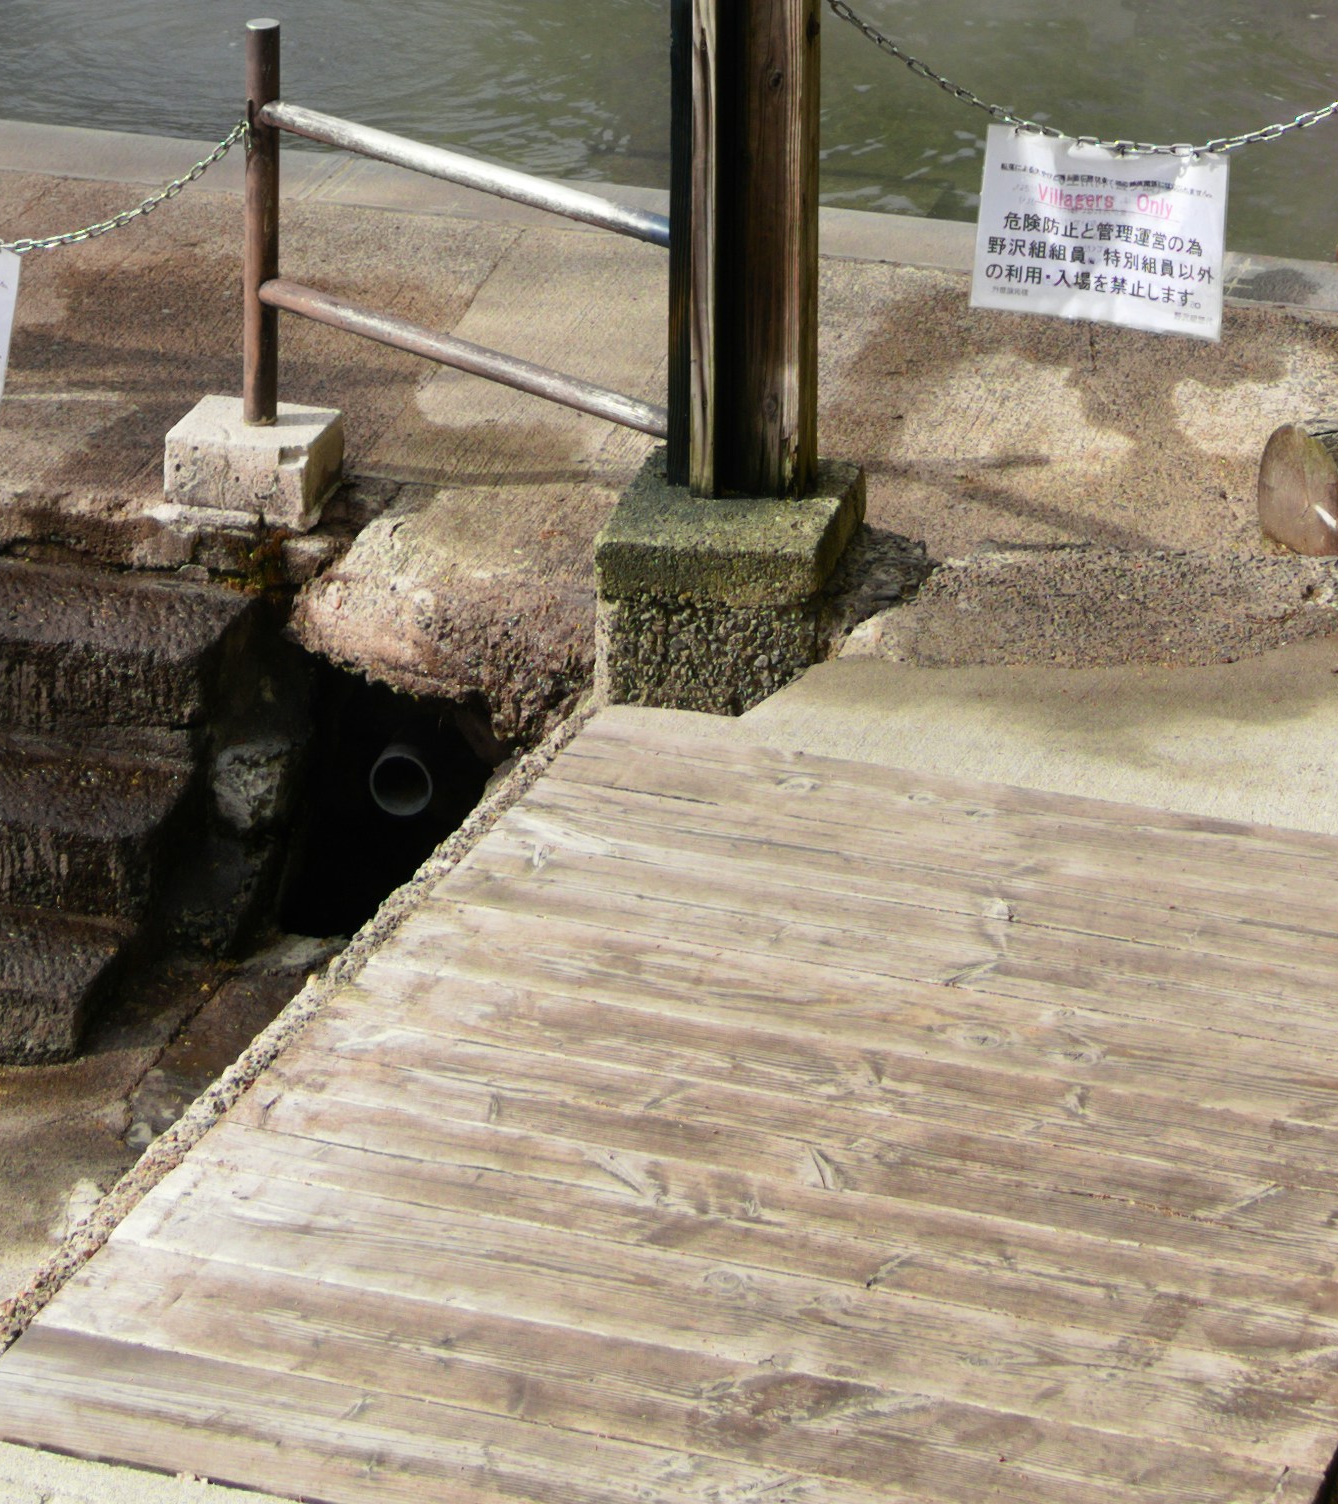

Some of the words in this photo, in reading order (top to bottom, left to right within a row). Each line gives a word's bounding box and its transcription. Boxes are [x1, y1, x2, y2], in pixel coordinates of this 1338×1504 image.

[1037, 183, 1115, 211] Villagers
[1136, 192, 1174, 220] Only
[1002, 211, 1204, 258] 危険防止と管理運営の為
[987, 236, 1215, 285] 野沢組組員、特別組員以外
[985, 263, 1202, 310] の利用・入場を禁止します。
